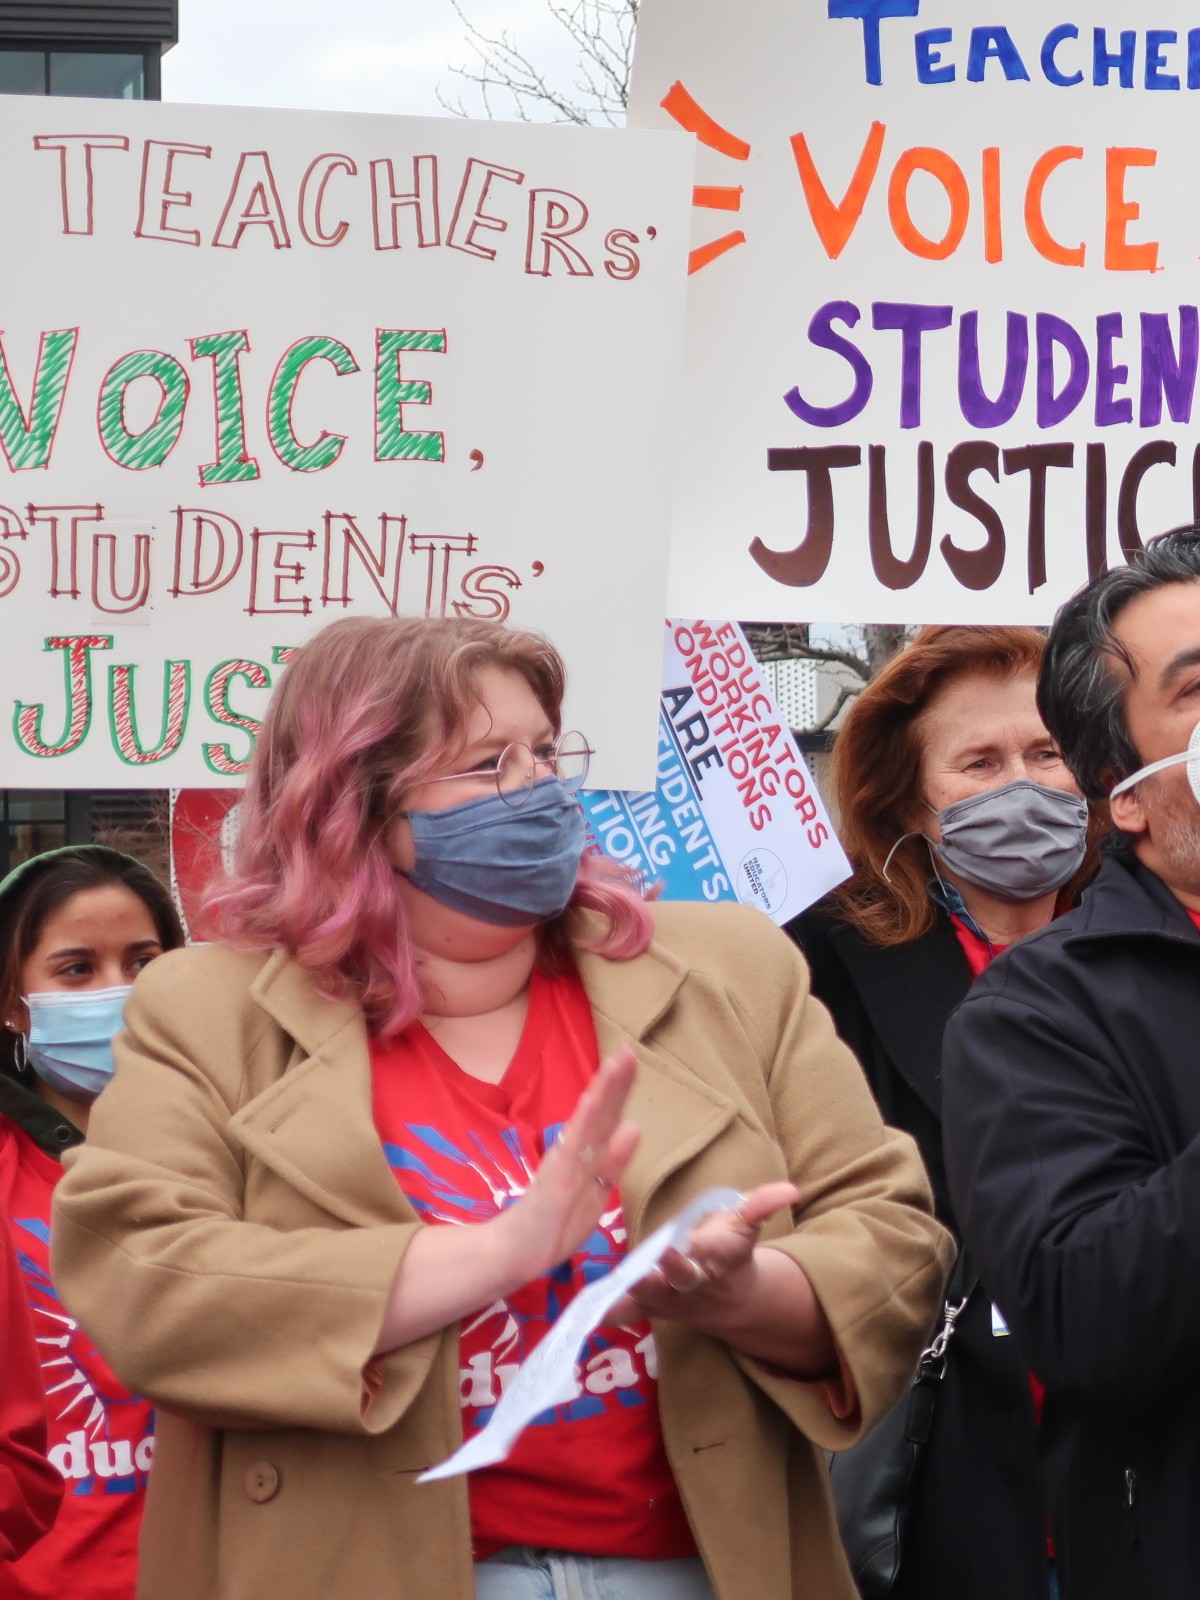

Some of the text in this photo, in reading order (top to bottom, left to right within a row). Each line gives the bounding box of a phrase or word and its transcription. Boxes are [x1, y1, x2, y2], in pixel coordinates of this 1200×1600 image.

[789, 120, 1164, 273] VOICE
[12, 634, 302, 776] JUS
[661, 685, 725, 782] ARE
[665, 618, 773, 832] ONDITIONS
[691, 619, 781, 798] WORKING
[714, 622, 829, 850] EDUCATORS
[743, 863, 759, 895] UNITED
[748, 859, 772, 910] EDUCATORS
[752, 856, 763, 875] NAS
